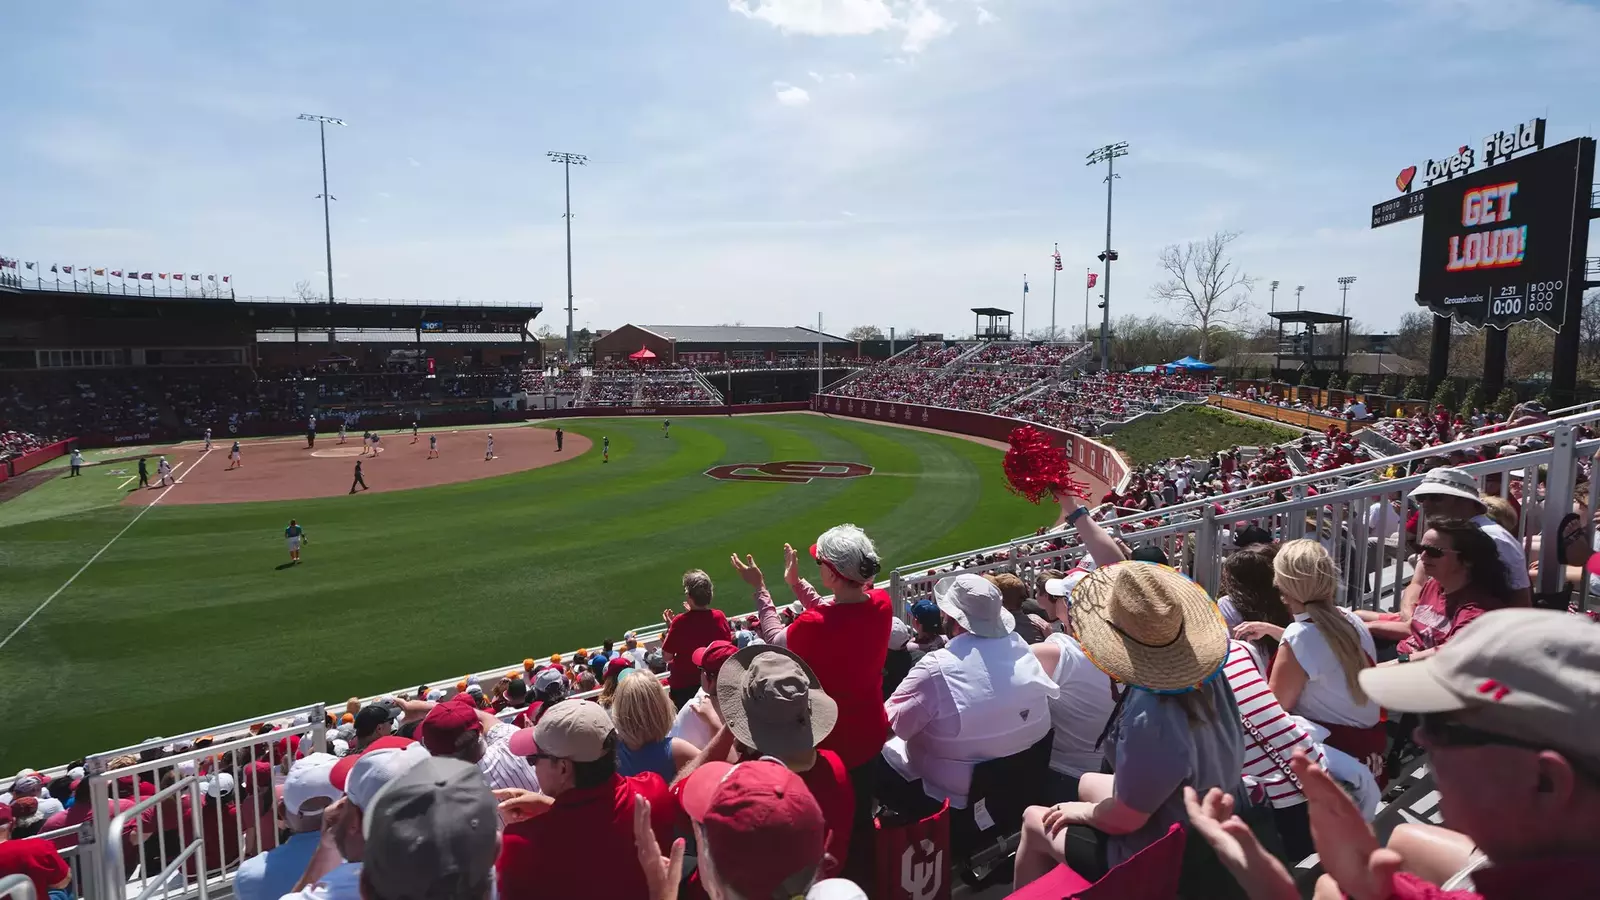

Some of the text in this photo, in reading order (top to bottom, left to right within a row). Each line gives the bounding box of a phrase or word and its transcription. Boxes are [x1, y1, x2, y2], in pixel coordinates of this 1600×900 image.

[1422, 118, 1538, 181] Love's Field
[1461, 181, 1519, 228] GET
[1445, 224, 1528, 272] LOUD!
[1443, 293, 1484, 305] Groundworks
[1493, 298, 1522, 315] 0:00
[1500, 285, 1516, 296] 2:31
